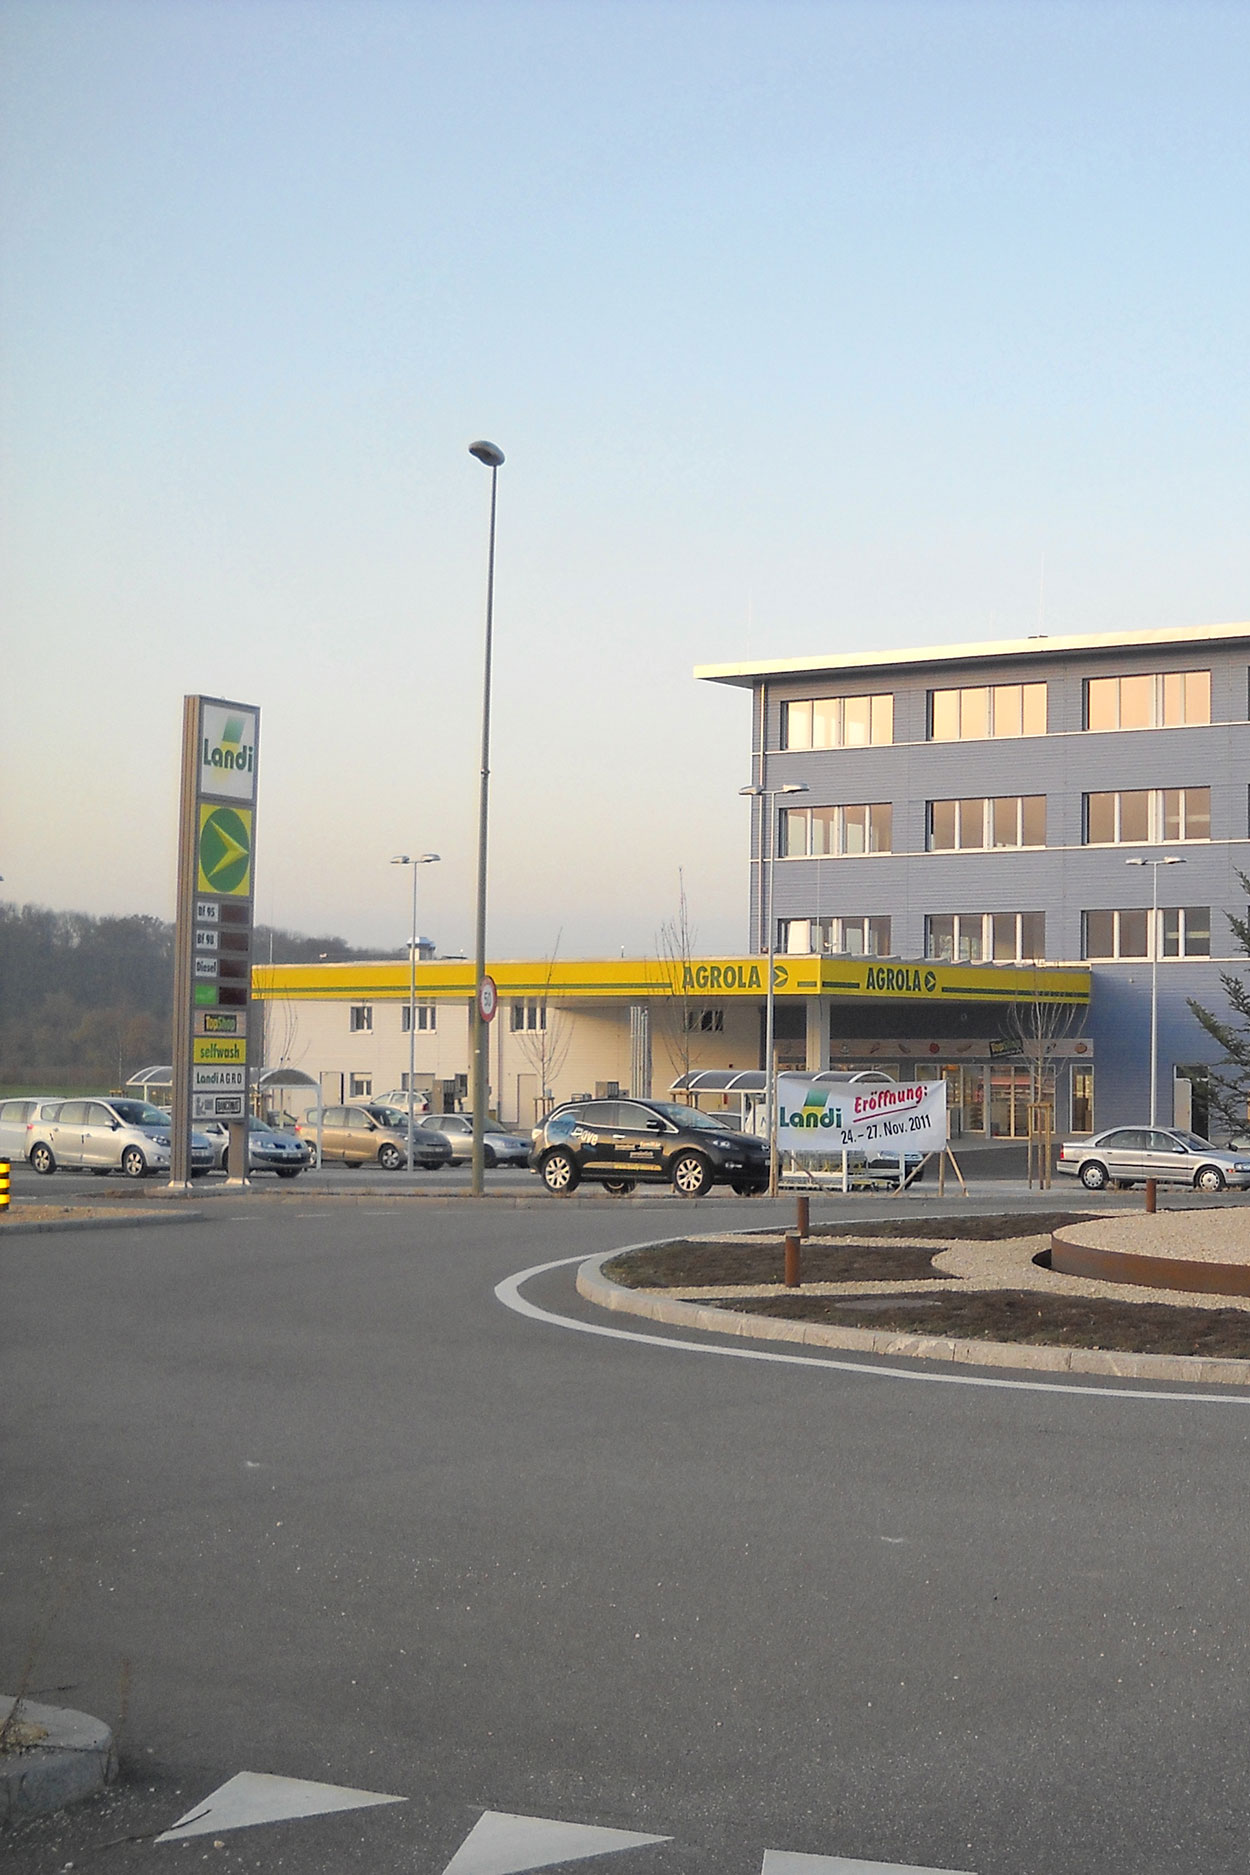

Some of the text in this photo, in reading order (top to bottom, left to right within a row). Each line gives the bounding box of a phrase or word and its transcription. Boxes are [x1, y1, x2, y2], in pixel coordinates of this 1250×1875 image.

[203, 738, 253, 772] Landi
[682, 966, 762, 988] AGROLA
[866, 967, 922, 991] AGROLA
[200, 1043, 240, 1058] selfwash
[854, 1085, 928, 1114] Eröffnung:
[780, 1107, 842, 1128] Landi
[884, 1120, 907, 1136] Nov.
[908, 1114, 931, 1131] 2011
